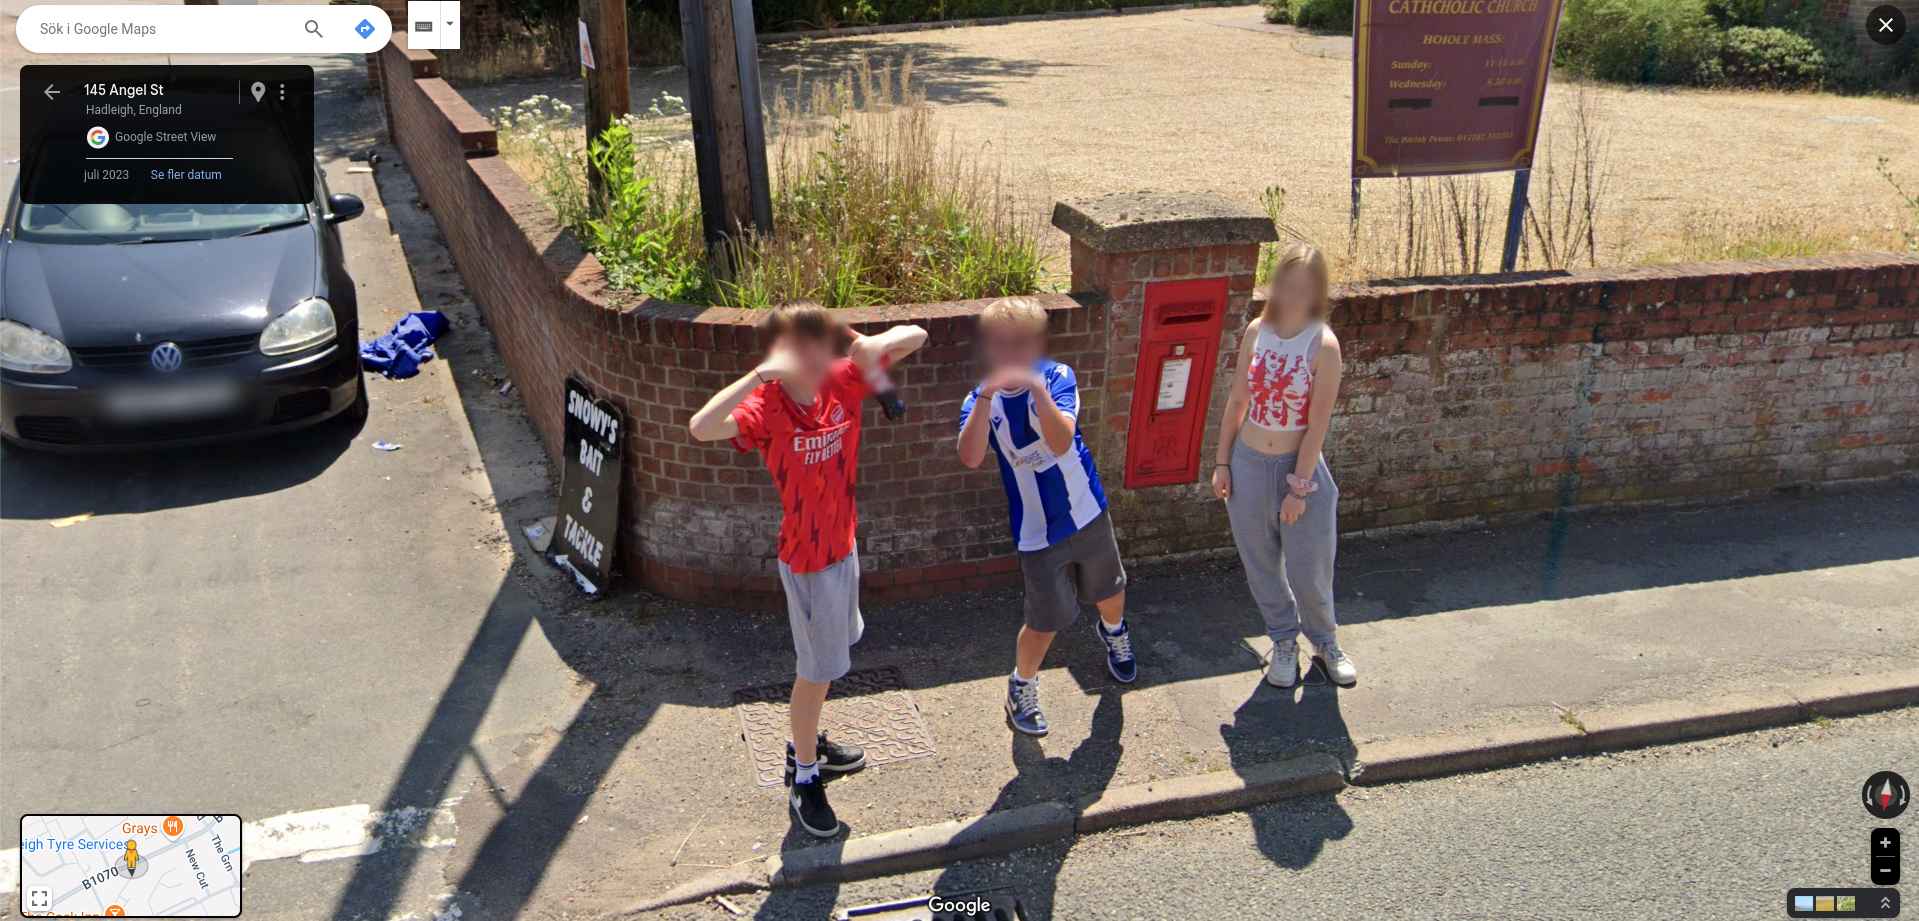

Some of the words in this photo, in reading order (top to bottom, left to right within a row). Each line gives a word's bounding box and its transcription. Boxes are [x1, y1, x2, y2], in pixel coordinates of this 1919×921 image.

[568, 389, 619, 445] SNOWY'S
[579, 438, 604, 477] BAIT
[564, 513, 604, 568] TACKLE
